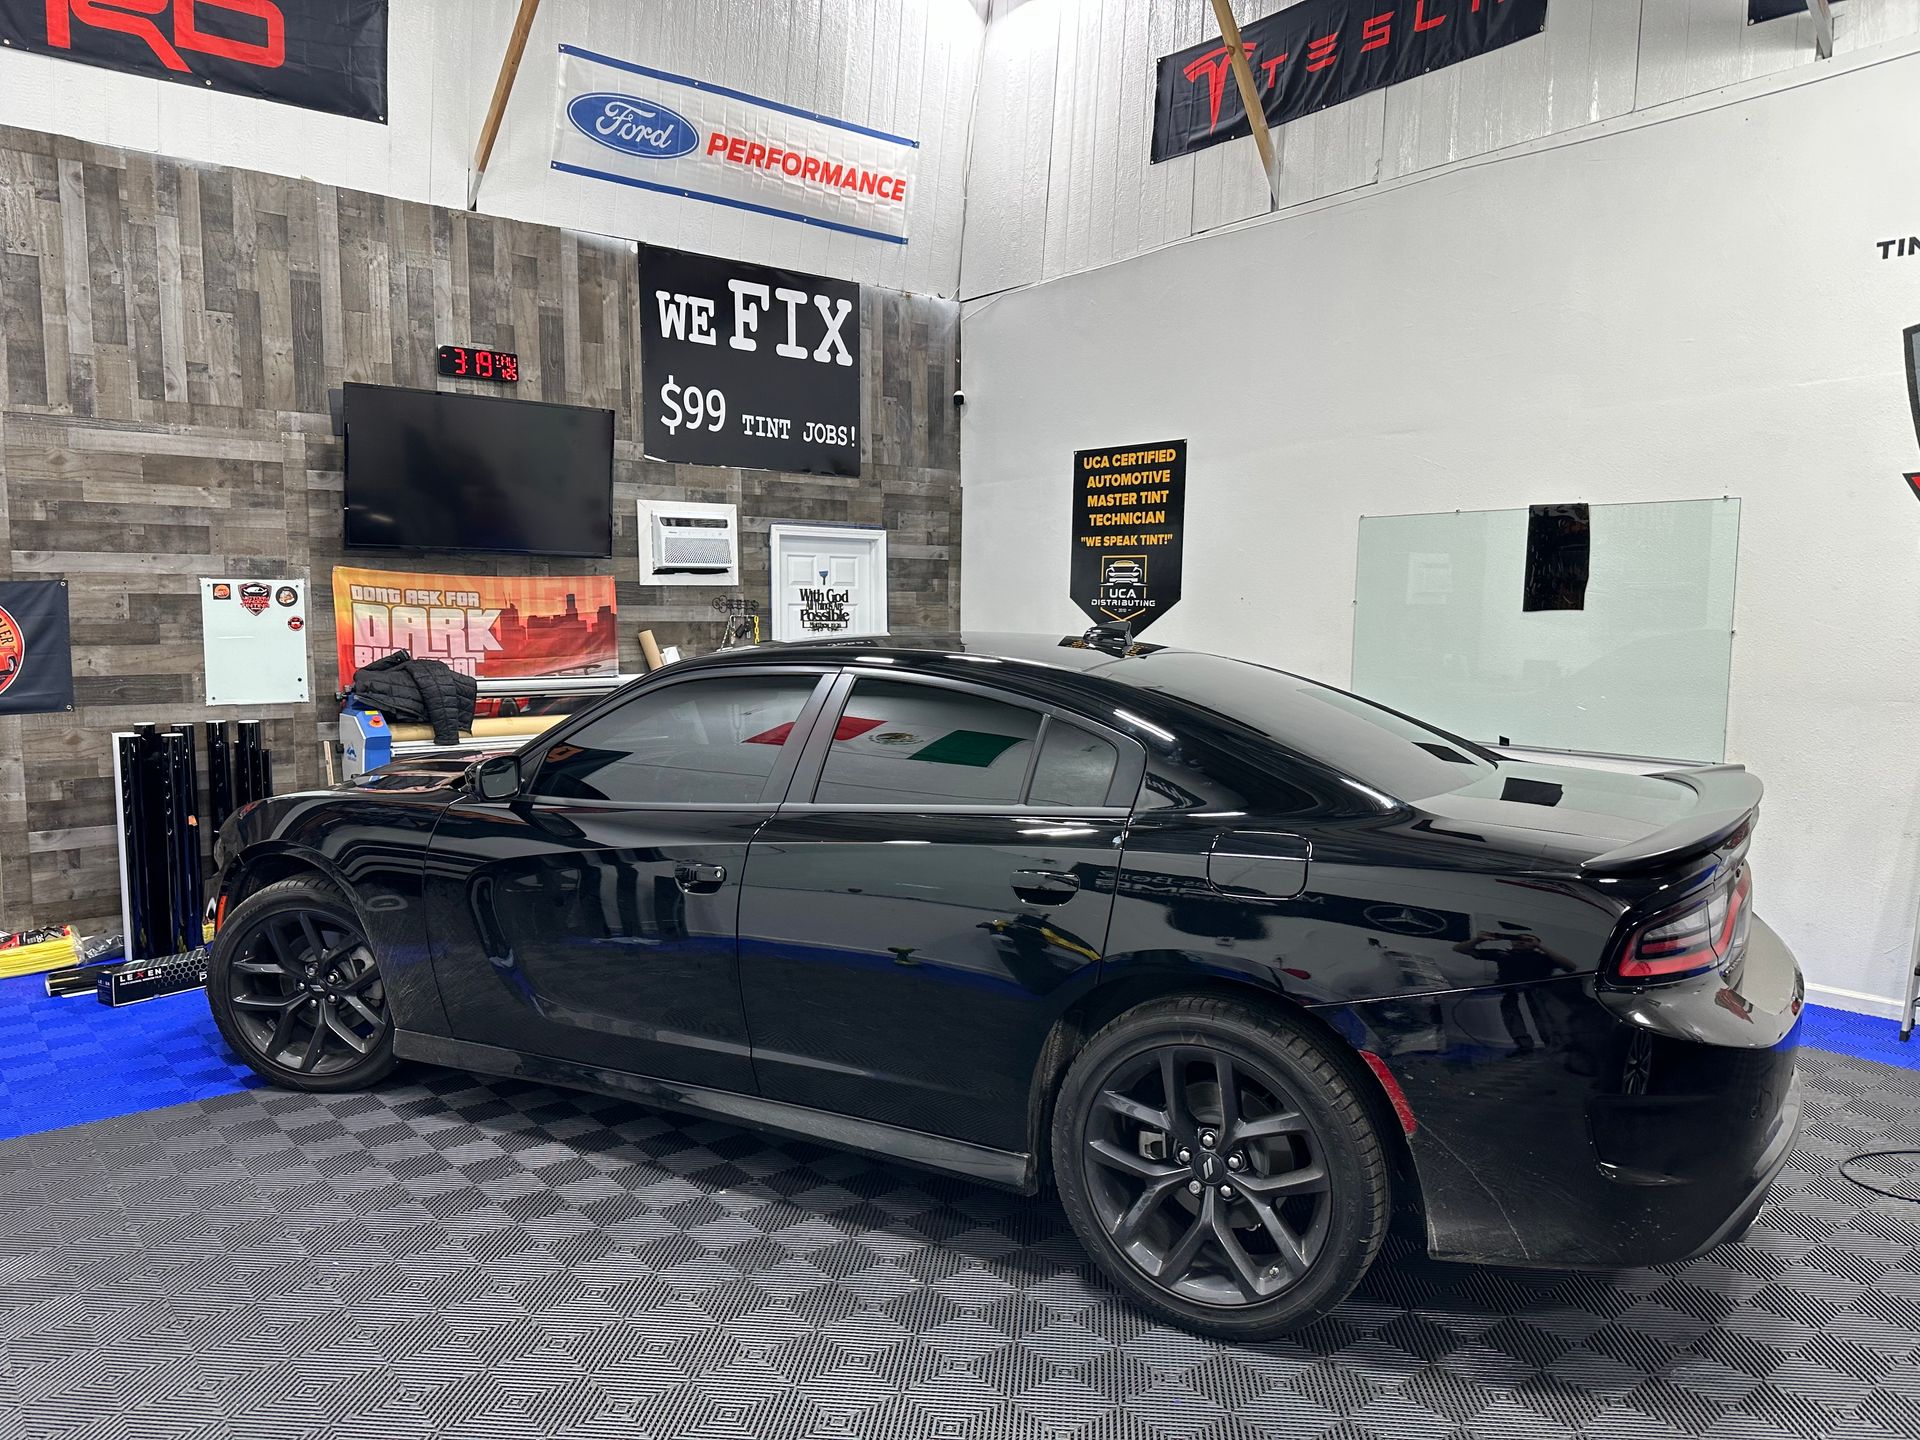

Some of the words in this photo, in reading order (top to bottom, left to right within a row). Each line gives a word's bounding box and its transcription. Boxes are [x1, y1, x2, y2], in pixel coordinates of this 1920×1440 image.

[1261, 0, 1504, 89] TESL
[595, 101, 675, 149] Ford
[706, 132, 906, 202] PERFORMANCE
[656, 290, 717, 346] WE
[728, 279, 853, 367] FIX
[660, 375, 726, 435] $99
[742, 415, 791, 439] TINT
[803, 422, 855, 447] JOBS!
[1083, 455, 1110, 469] UCA
[1112, 449, 1177, 467] CERTIFIED
[1086, 470, 1170, 488] AUTOMOTIVE
[1087, 492, 1137, 507] MASTER
[1140, 490, 1169, 504] TINT
[1089, 511, 1165, 526] TECHNICIAN
[1081, 536, 1101, 547] "WE
[1103, 535, 1138, 546] SPEAK
[1140, 534, 1173, 545] TINT!"
[404, 589, 442, 606] ASK
[444, 591, 480, 607] FOR
[799, 588, 825, 603] With
[826, 588, 849, 603] God
[1109, 588, 1137, 599] UCA
[1091, 599, 1156, 607] DISTRIBUTING
[800, 609, 850, 621] Possible
[352, 602, 504, 652] DARK
[119, 968, 162, 983] LEXEN
